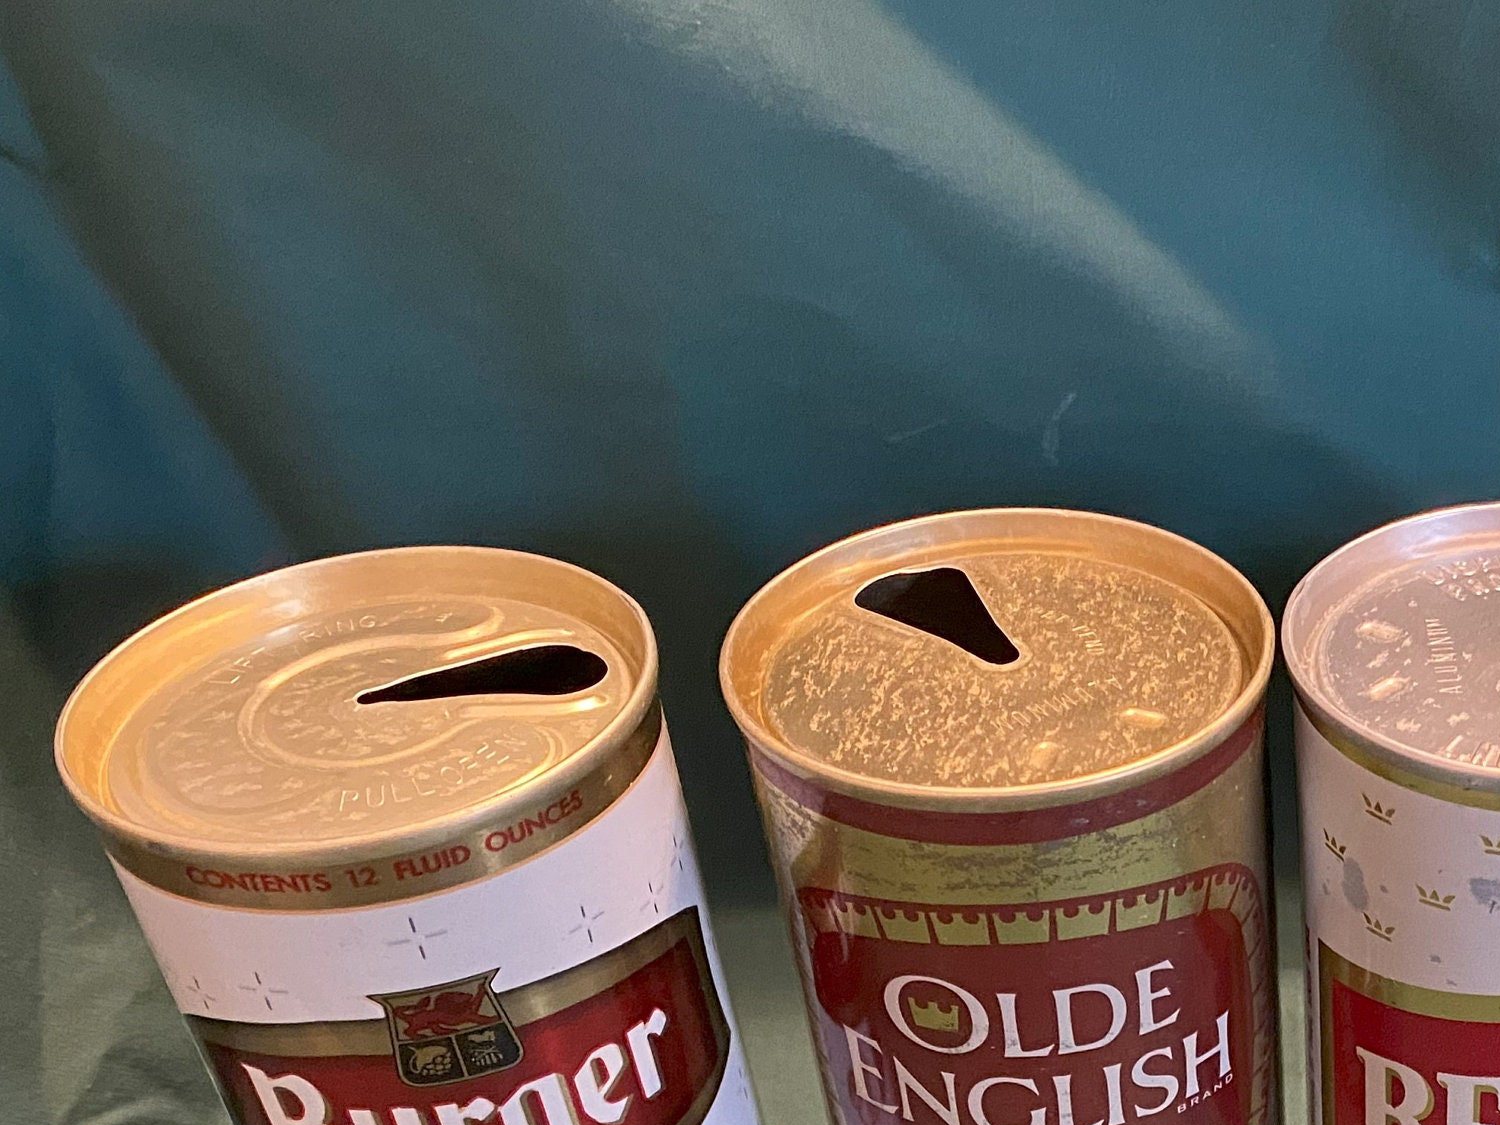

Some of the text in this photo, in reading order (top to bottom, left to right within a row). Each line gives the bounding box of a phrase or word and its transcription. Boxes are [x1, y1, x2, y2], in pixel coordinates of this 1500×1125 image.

[339, 776, 437, 813] PULL
[185, 790, 584, 895] CONTENTS 12 FLUID OUNCES
[882, 958, 1182, 1060] OLDE
[1176, 1072, 1234, 1115] BRAND
